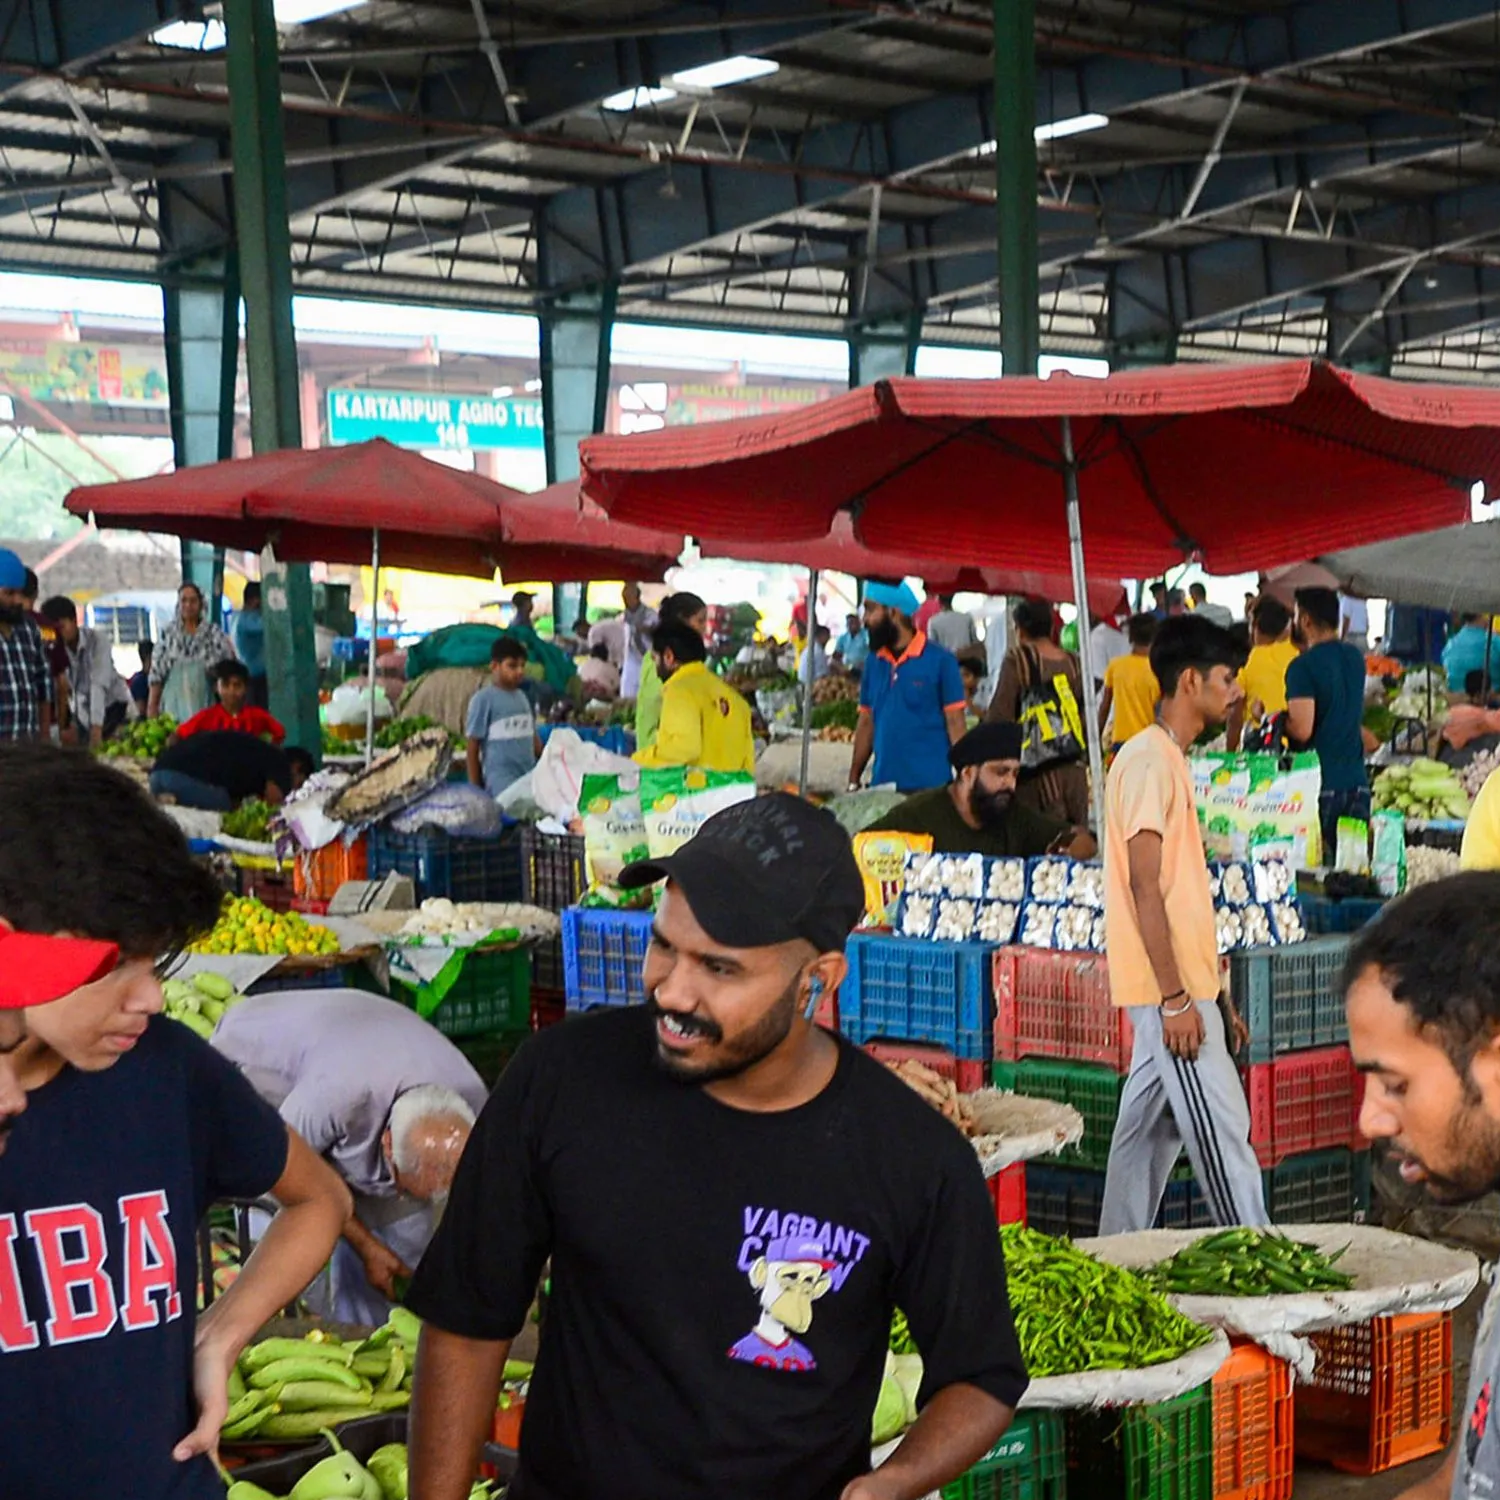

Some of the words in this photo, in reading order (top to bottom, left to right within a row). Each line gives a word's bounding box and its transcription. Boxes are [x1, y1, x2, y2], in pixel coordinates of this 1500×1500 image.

[335, 394, 452, 422] KARTARPUR
[458, 401, 508, 426] AGRO
[744, 1206, 871, 1263] VAGRANT
